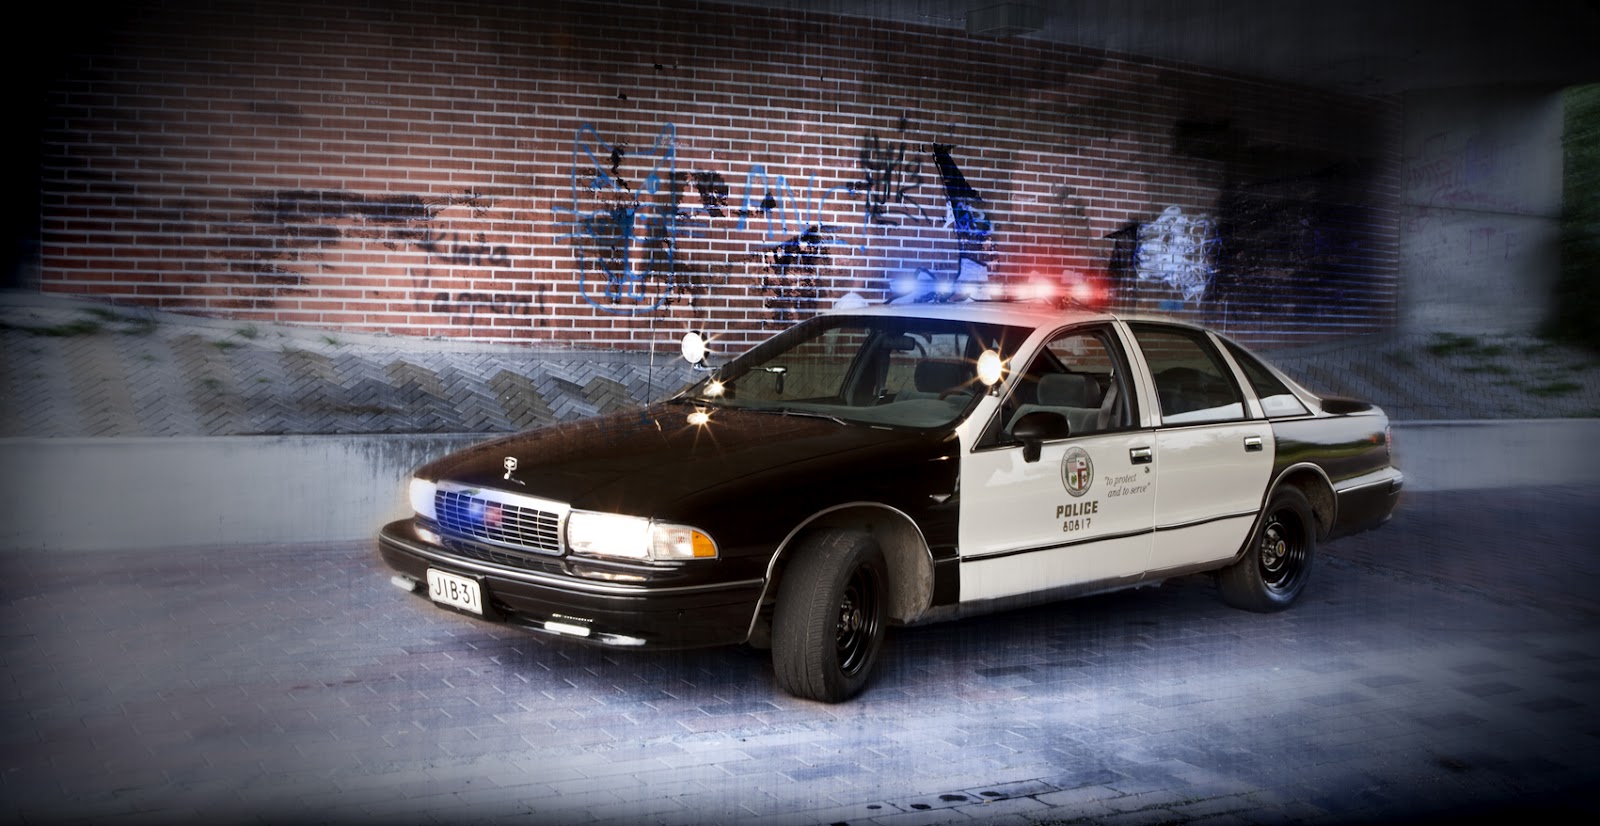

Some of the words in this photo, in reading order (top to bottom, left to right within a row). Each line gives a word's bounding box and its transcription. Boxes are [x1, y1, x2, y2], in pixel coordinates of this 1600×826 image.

[1113, 473, 1137, 487] protect
[1107, 485, 1122, 498] and
[1122, 487, 1130, 496] to
[1056, 500, 1099, 519] POLICE
[1063, 518, 1091, 532] 80817
[434, 576, 477, 607] JIB-31
